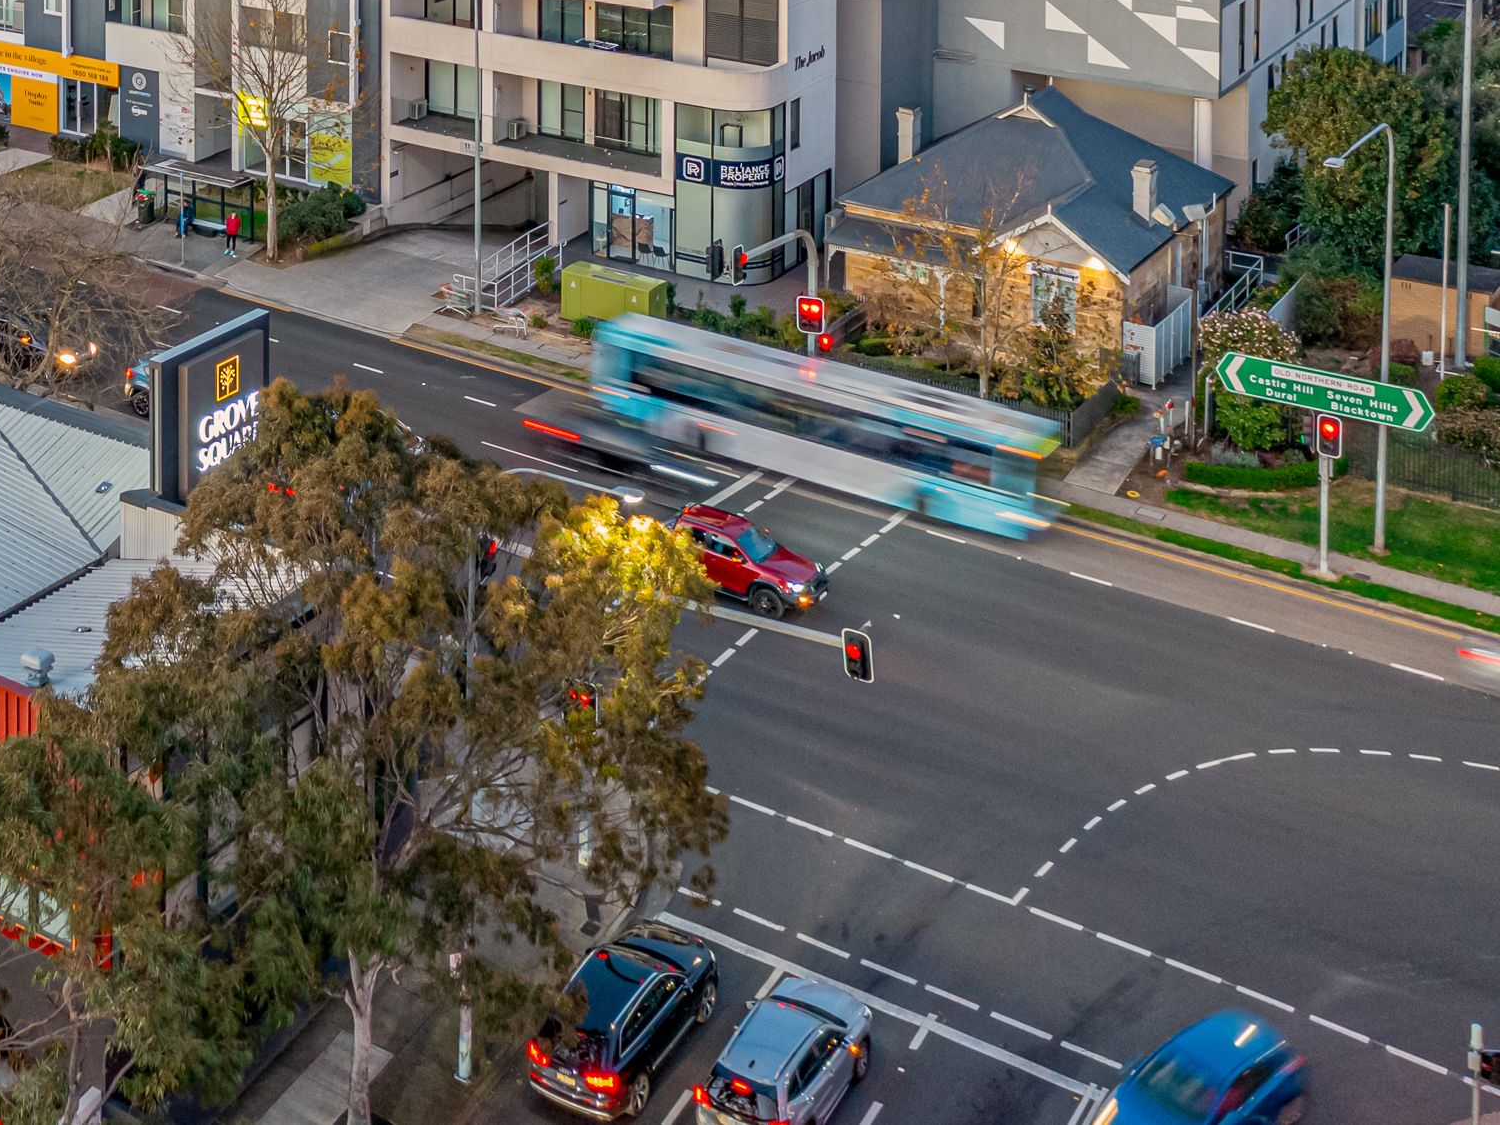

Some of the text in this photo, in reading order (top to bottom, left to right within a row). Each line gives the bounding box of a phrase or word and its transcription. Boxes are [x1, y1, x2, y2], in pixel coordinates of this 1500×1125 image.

[720, 163, 770, 174] RELIANCE
[720, 172, 769, 181] PROPERTY
[1249, 374, 1314, 396] Castle Hill
[1273, 368, 1373, 394] OLD NORTHERN ROAD
[1265, 388, 1297, 402] Dural
[1326, 390, 1398, 413] Seven Hills
[198, 391, 259, 443] GROVE
[1330, 401, 1394, 423] Blacktown
